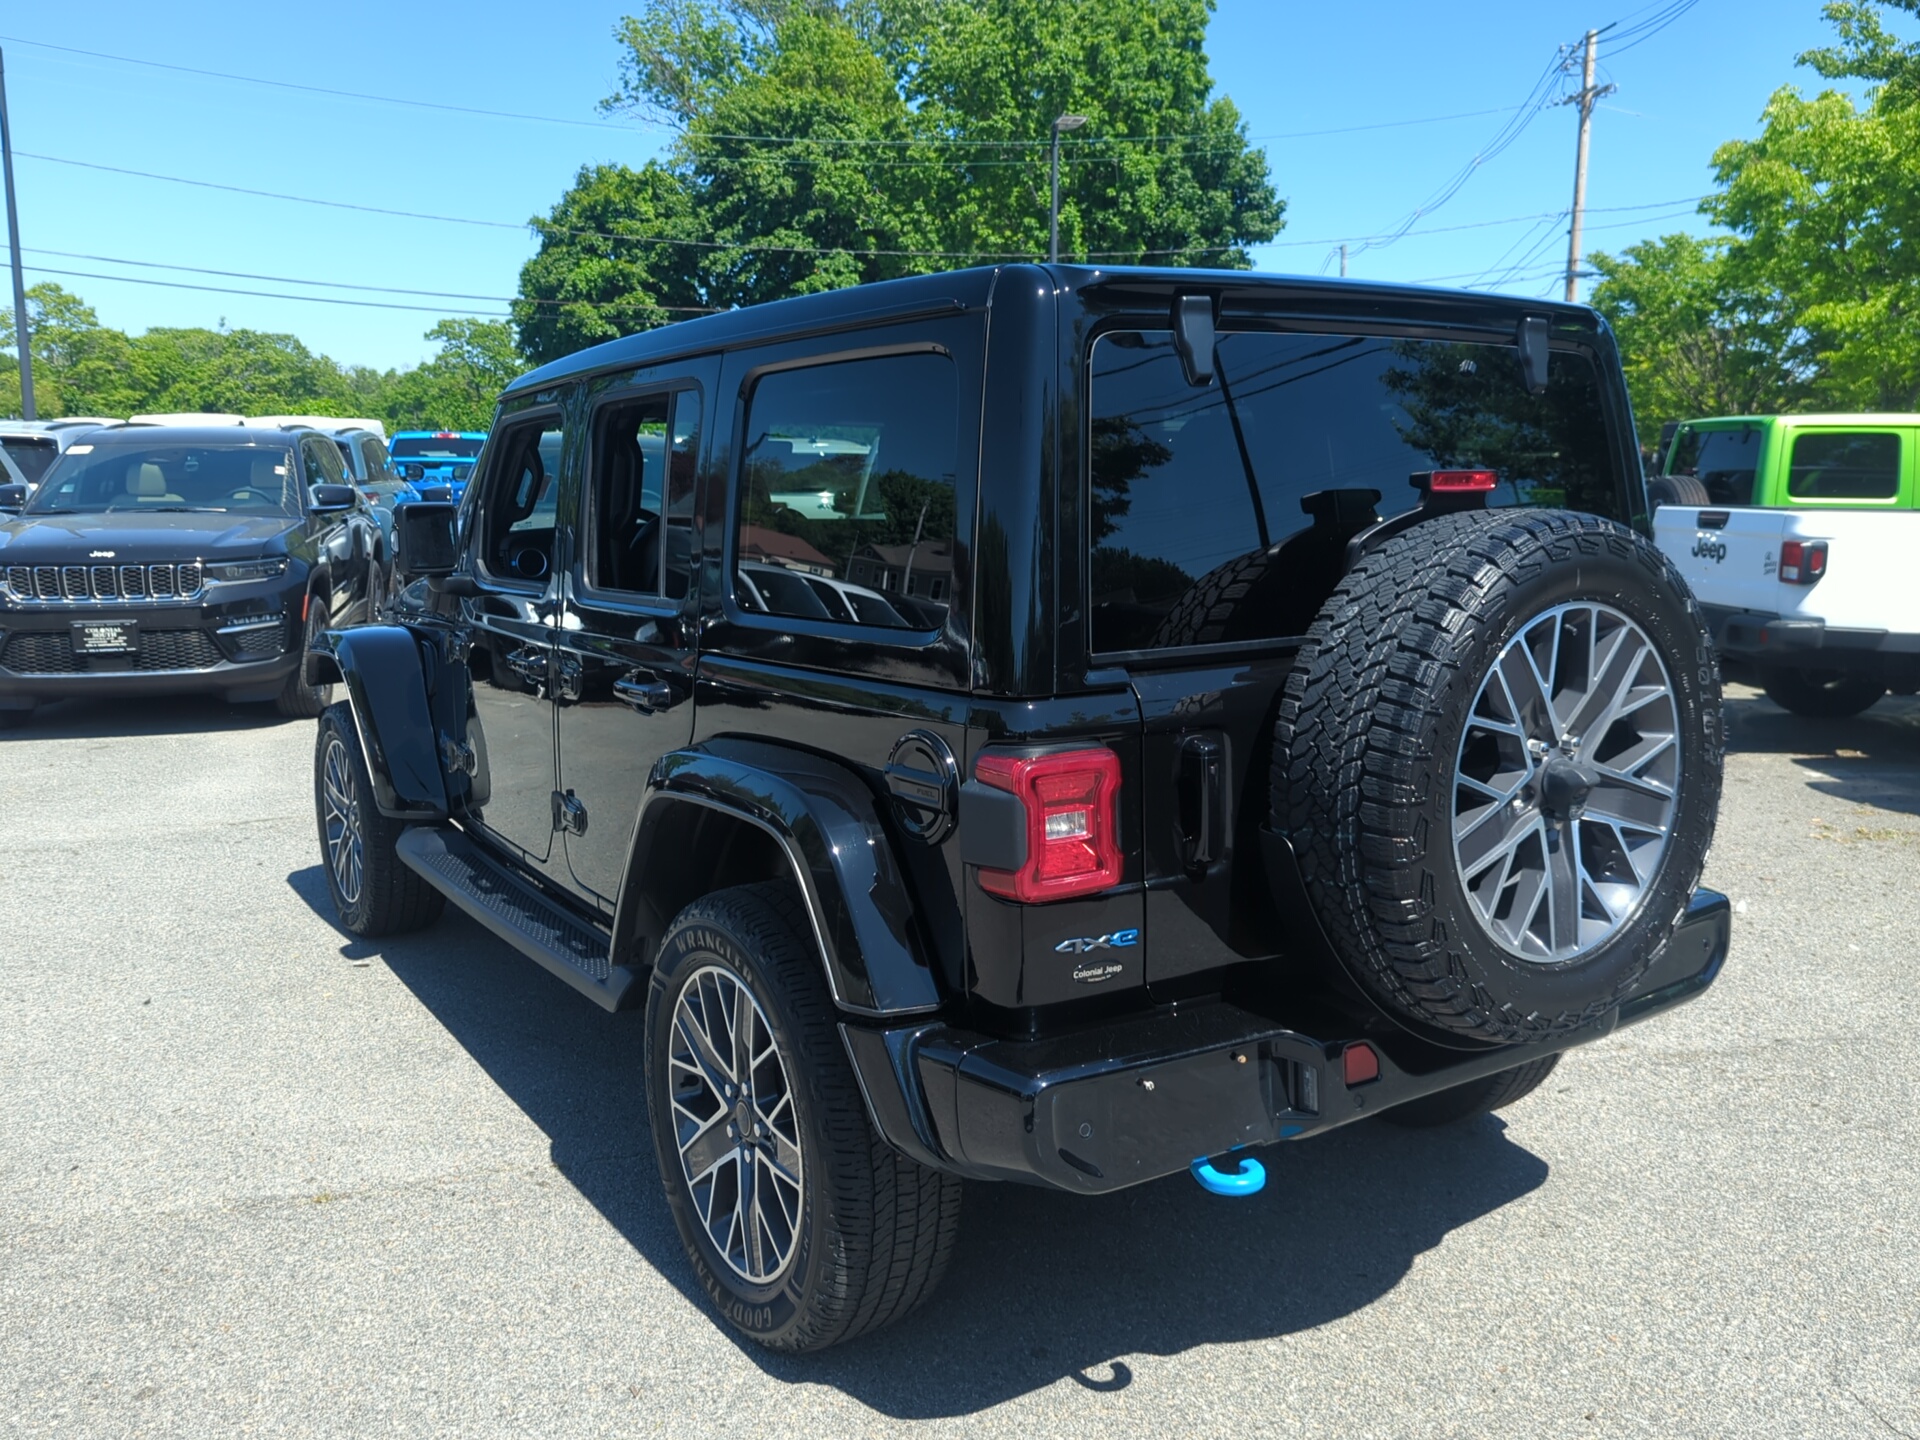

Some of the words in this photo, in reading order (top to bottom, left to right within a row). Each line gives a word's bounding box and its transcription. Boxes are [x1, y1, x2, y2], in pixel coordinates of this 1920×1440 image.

[1691, 537, 1726, 564] Jeep
[916, 788, 936, 798] FUEL
[675, 930, 753, 984] WRANGLER
[1073, 967, 1103, 979] Colonial
[1104, 964, 1122, 974] Jeep
